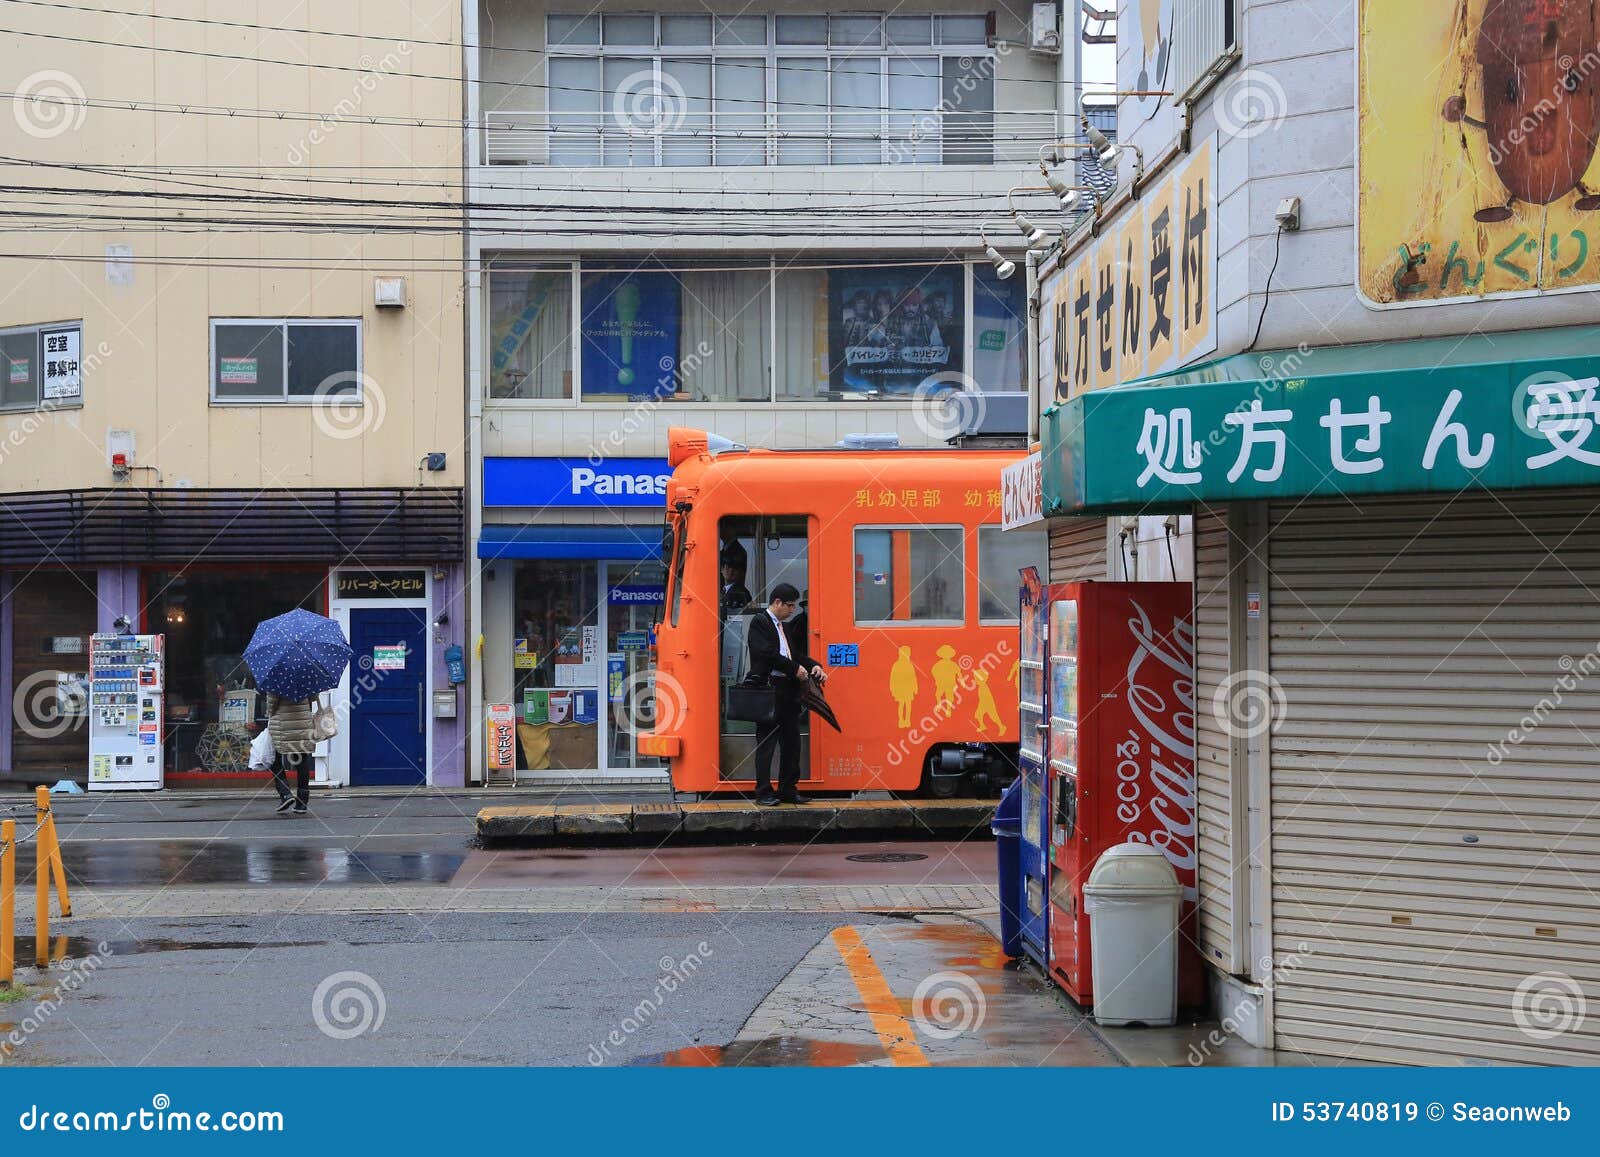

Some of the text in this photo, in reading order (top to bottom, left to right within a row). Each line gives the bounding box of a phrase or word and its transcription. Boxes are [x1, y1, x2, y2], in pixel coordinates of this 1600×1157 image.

[1393, 229, 1589, 293] どんぐり
[1053, 177, 1208, 399] 処方せん受付
[47, 335, 68, 353] 空室
[851, 350, 887, 360] パイレーツ
[912, 349, 946, 359] カリビアン
[47, 360, 78, 378] 募集中
[1135, 376, 1600, 489] 処方せん受
[855, 489, 941, 508] 乳幼児部
[338, 579, 423, 590] リバーオークビル
[830, 653, 857, 665] 出口
[498, 725, 512, 765] ケーブルテレビ
